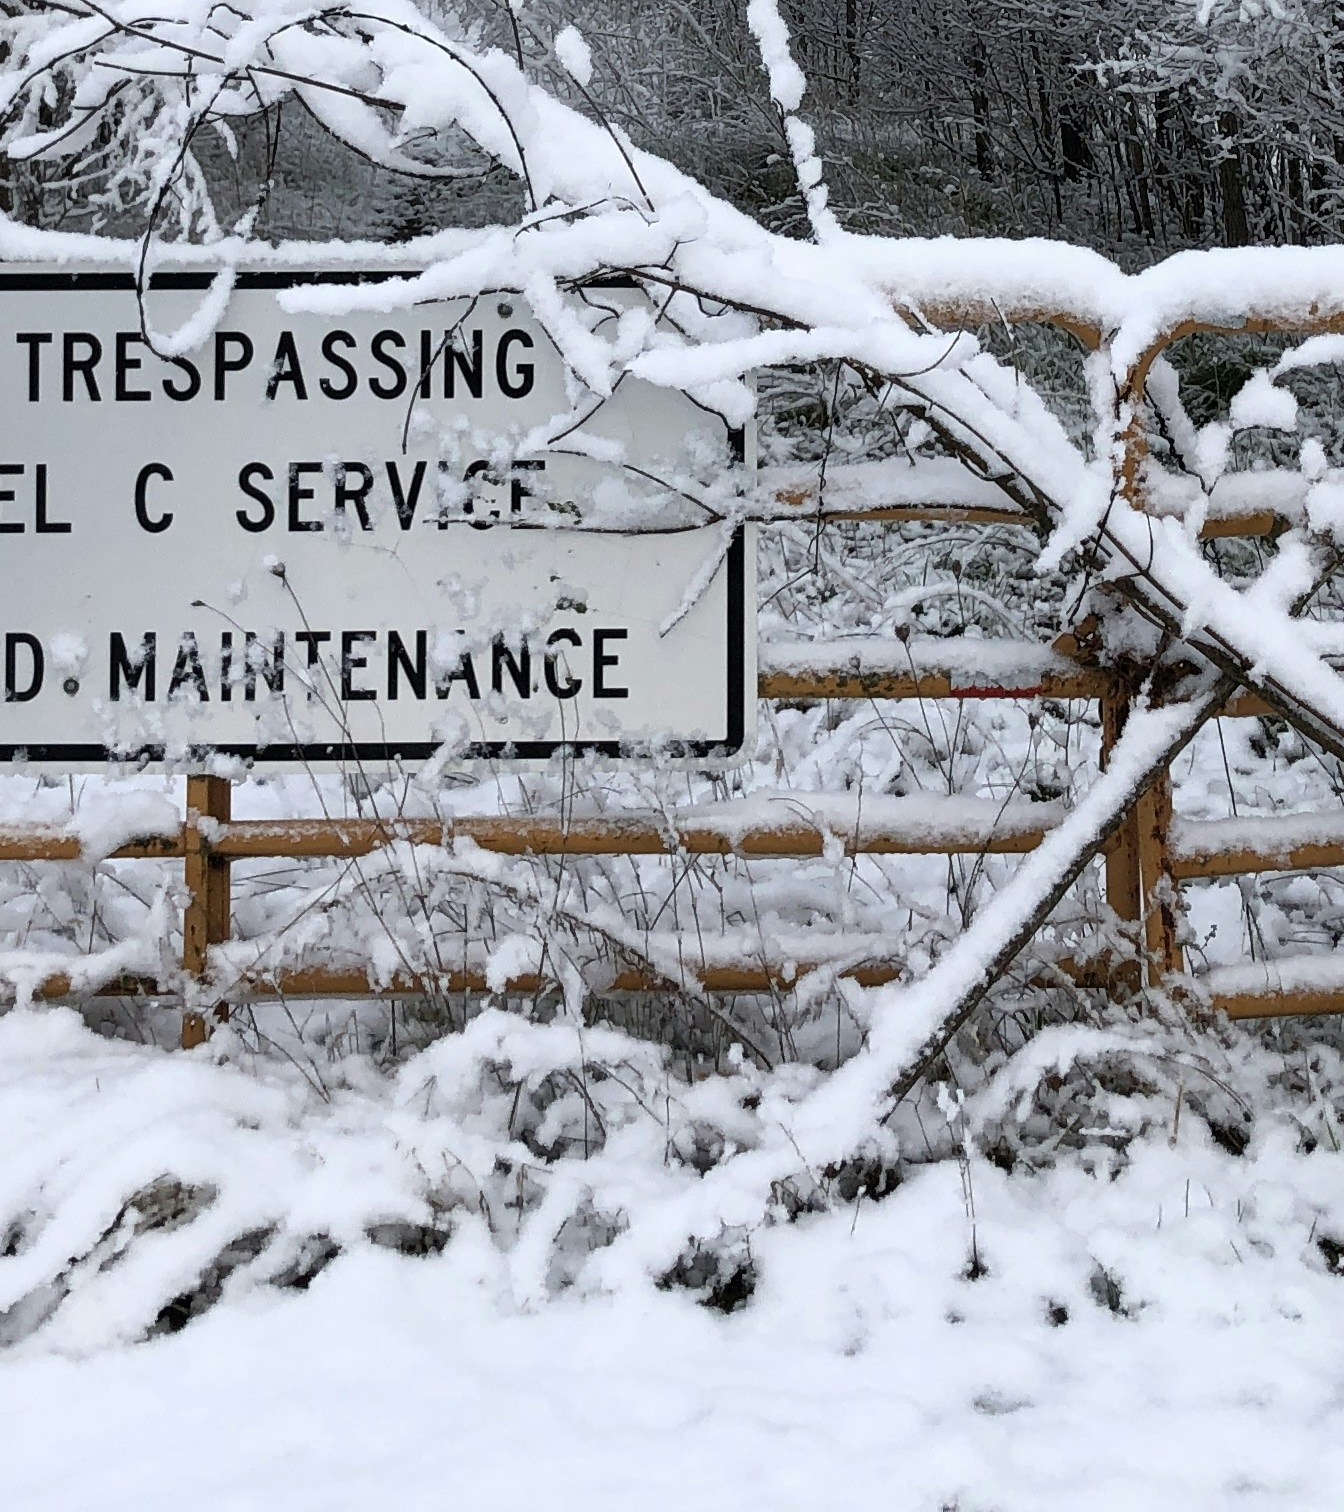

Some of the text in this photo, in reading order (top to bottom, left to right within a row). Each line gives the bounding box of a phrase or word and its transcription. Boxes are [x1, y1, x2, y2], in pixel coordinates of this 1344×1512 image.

[16, 329, 535, 402] TRESPASSING
[135, 462, 174, 533] C
[109, 628, 629, 702] MAINTENANCE
